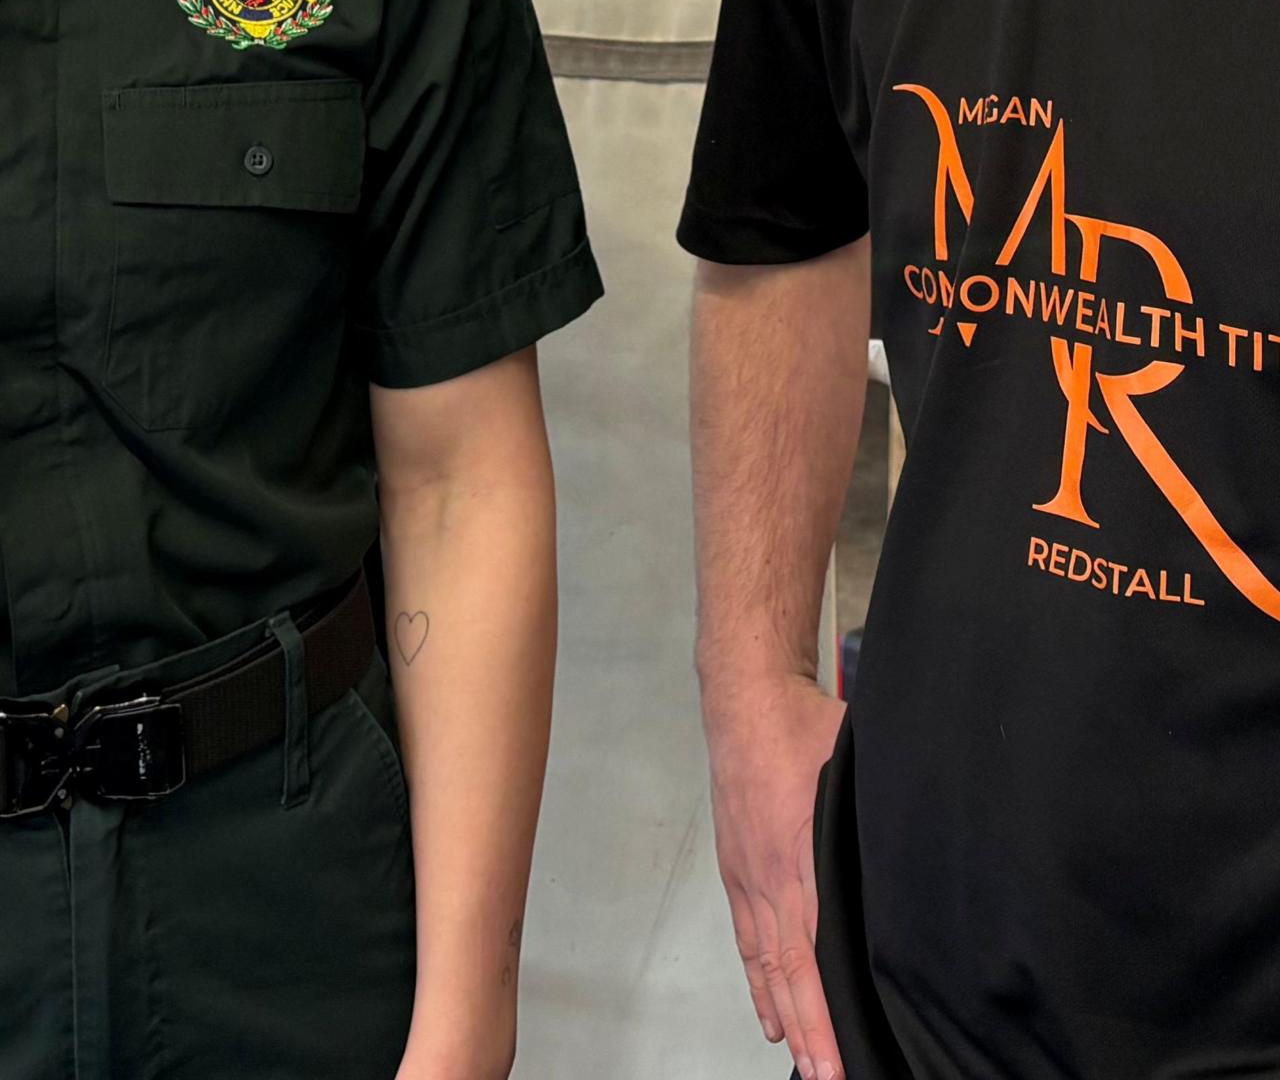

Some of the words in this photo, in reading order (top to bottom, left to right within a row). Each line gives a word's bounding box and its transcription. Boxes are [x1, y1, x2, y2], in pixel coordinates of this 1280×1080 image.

[958, 93, 1053, 129] MGAN
[903, 264, 1206, 358] COMONWEALTH
[1027, 536, 1206, 607] REDSTALL
